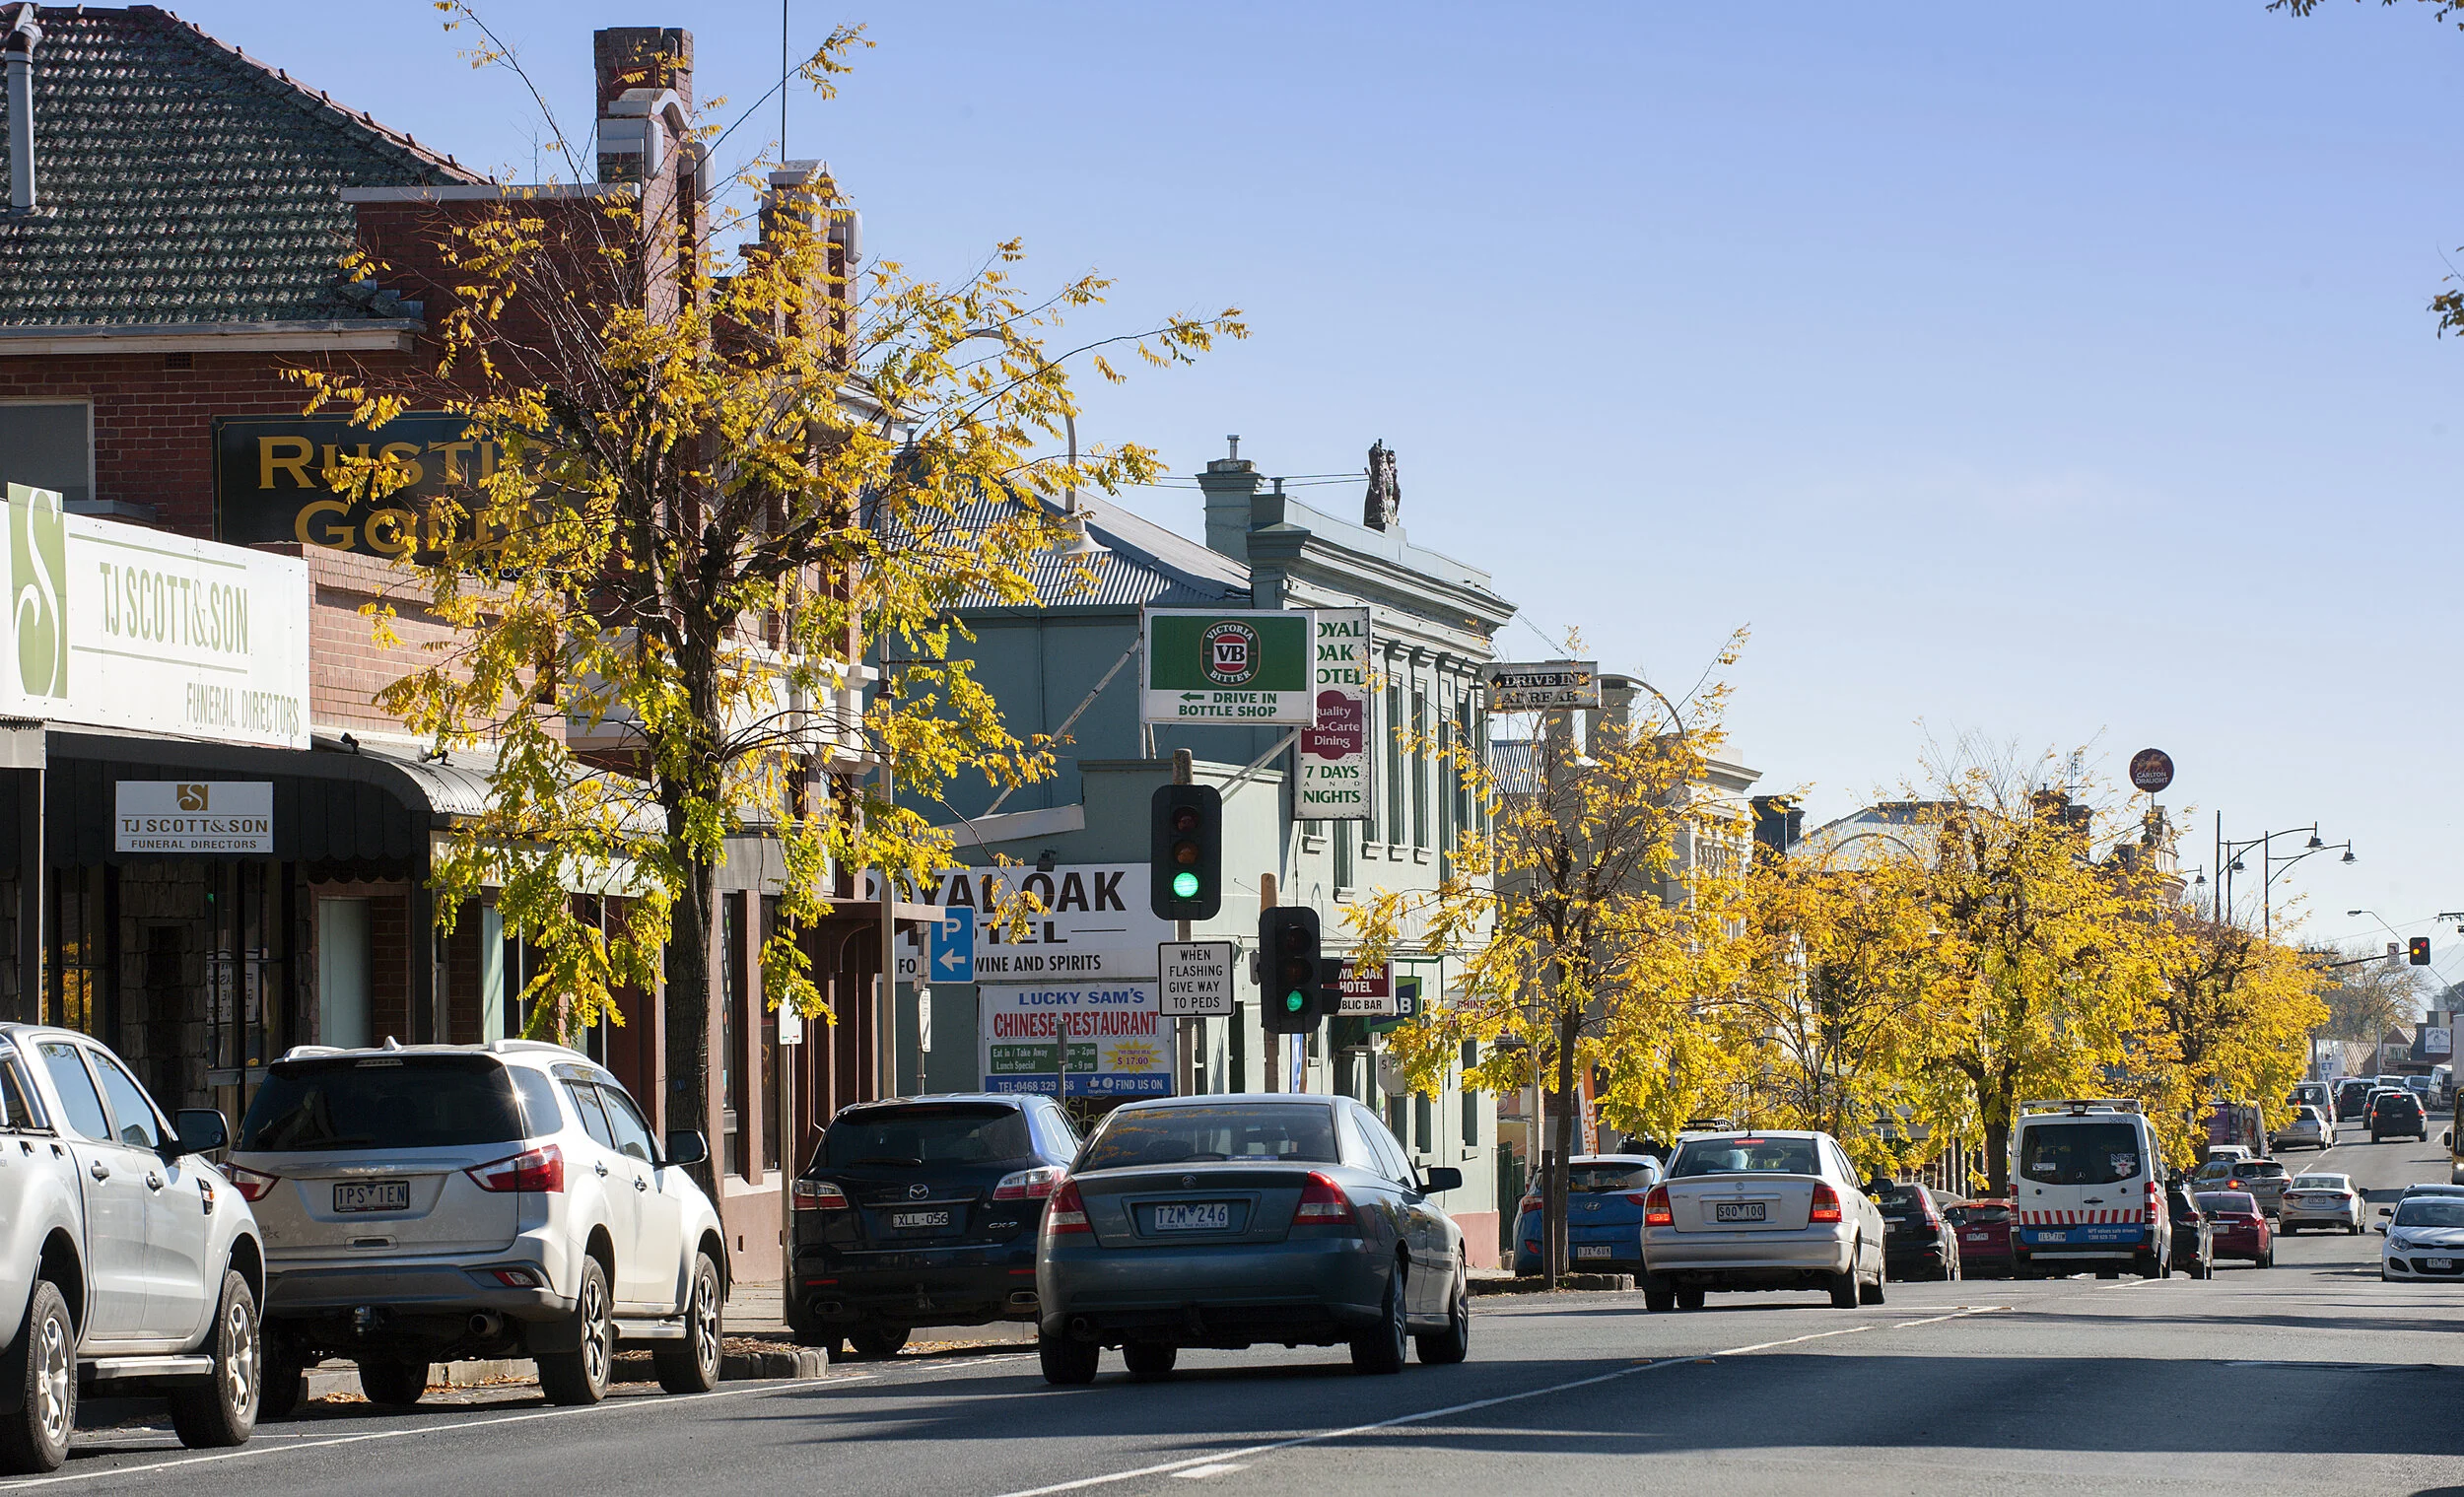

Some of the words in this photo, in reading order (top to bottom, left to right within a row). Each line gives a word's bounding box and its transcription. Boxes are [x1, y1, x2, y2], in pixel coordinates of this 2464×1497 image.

[100, 561, 119, 637] TJ
[1206, 625, 1254, 642] VICTORIA
[1317, 620, 1364, 638] OYAL
[1215, 645, 1246, 661] VB
[1209, 670, 1252, 683] BITTER
[1317, 668, 1366, 685] OTEL
[1504, 674, 1556, 687] DRIVE
[1212, 692, 1258, 704] DRIVE
[1262, 692, 1277, 704] IN
[186, 682, 237, 727] FUNERAL
[241, 690, 300, 736] DIRECTORS
[1178, 705, 1233, 716] BOTTLE
[1237, 706, 1277, 717] SHOP
[1314, 735, 1351, 749] Dining
[1304, 766, 1315, 779] 7
[1321, 766, 1360, 779] DAYS
[1303, 790, 1361, 803] NIGHTS
[121, 819, 140, 833] TJ
[131, 840, 185, 849] FUNERAL
[191, 840, 257, 849] DIRECTORS
[1021, 871, 1127, 914] OAK
[942, 918, 961, 942] P
[1180, 949, 1211, 961] WHEN
[1014, 955, 1045, 972] AND
[1050, 954, 1102, 971] SPIRITS
[1169, 965, 1223, 977] FLASHING
[1169, 982, 1194, 992] GIVE
[1198, 981, 1220, 992] WAY
[1339, 981, 1373, 993] HOTEL
[1018, 991, 1081, 1006] LUCKY
[1087, 987, 1145, 1004] SAM'S
[1173, 997, 1187, 1008] TO
[1191, 996, 1220, 1008] PEDS
[1339, 999, 1362, 1010] BLIC
[1364, 999, 1383, 1010] BAR
[993, 1012, 1058, 1037] CHINESE
[1062, 1011, 1160, 1037] RESTAURANT
[992, 1048, 1004, 1057] Eat
[1005, 1049, 1011, 1057] in
[1016, 1048, 1032, 1057] Take
[1033, 1048, 1048, 1058] Away
[996, 1060, 1014, 1071] Lunch
[1014, 1060, 1036, 1072] Special
[1126, 1056, 1149, 1065] 17.00
[1040, 1080, 1057, 1091] 329
[1115, 1079, 1135, 1090] FIND
[1137, 1079, 1149, 1090] US
[1150, 1079, 1164, 1090] ON
[338, 1187, 365, 1204] 1PS
[378, 1186, 405, 1202] 1EN
[1157, 1207, 1186, 1223] TZM
[1198, 1206, 1226, 1222] 246
